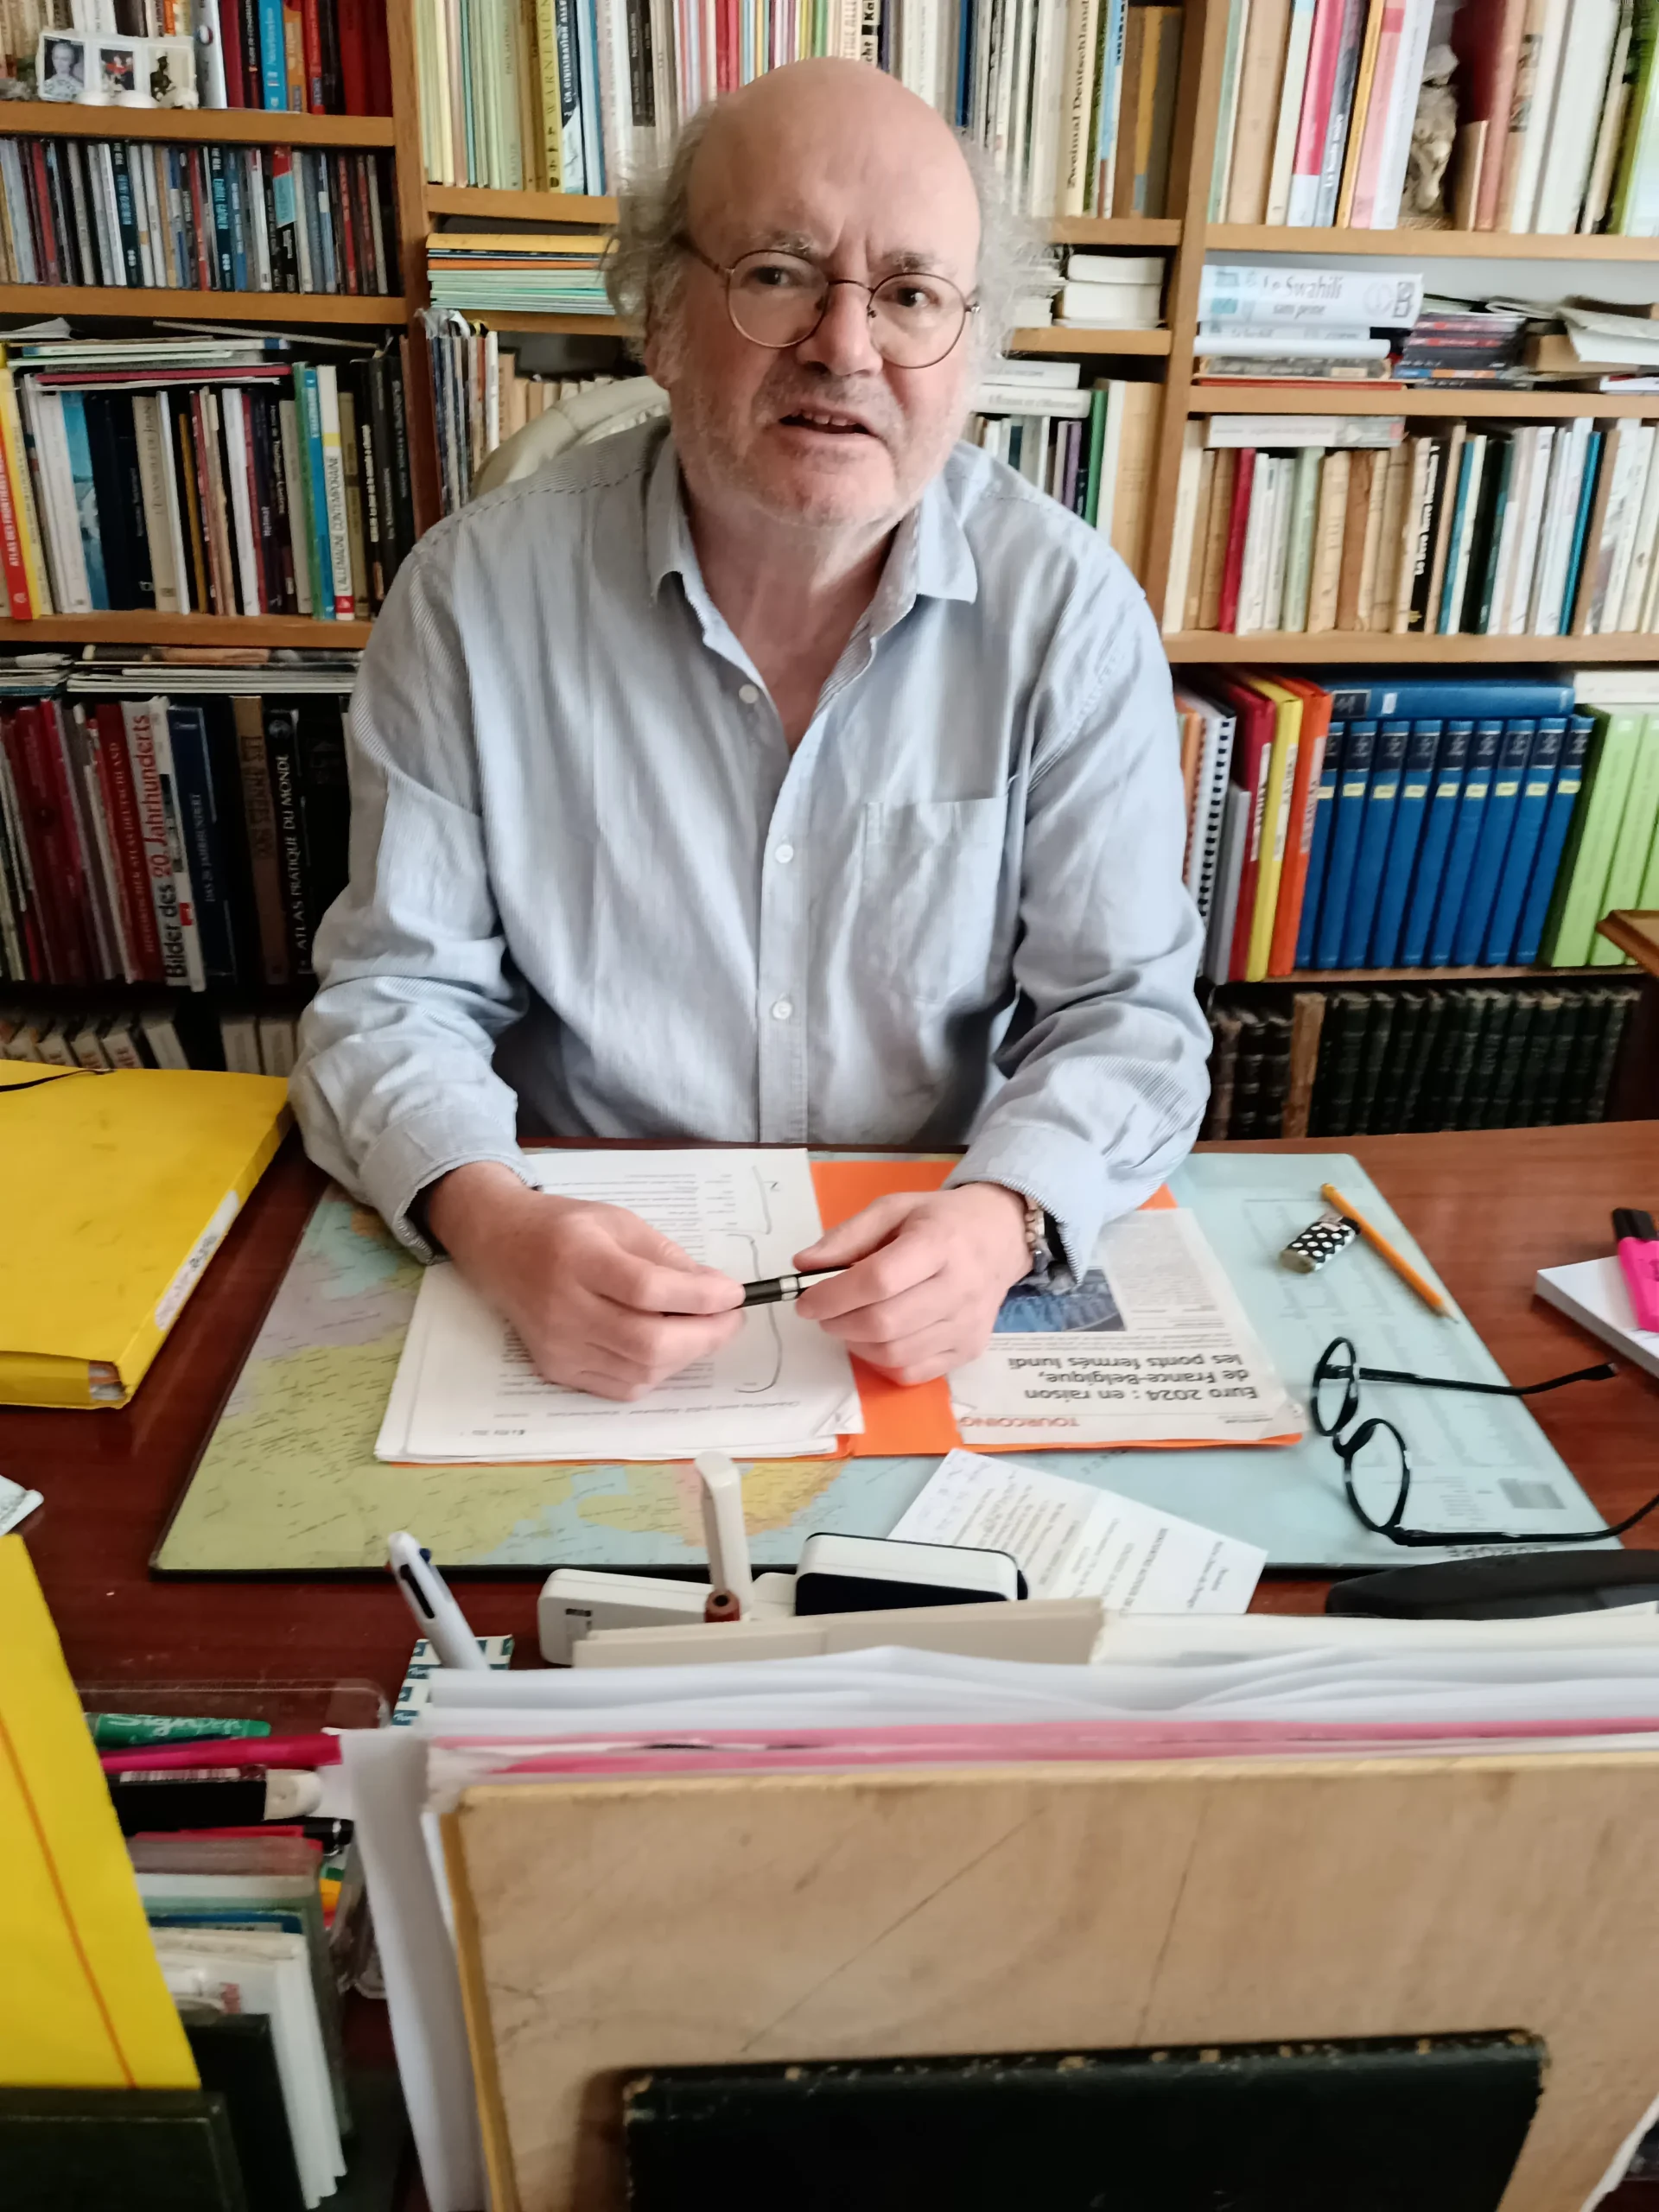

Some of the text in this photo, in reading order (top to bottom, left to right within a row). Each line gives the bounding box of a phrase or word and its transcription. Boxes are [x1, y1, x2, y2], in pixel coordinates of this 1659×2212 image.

[1066, 0, 1090, 189] Zweimal Deutschland
[1286, 275, 1344, 299] Swahili
[328, 456, 345, 532] CONTEMPORAINE
[275, 753, 294, 807] MONDE
[283, 811, 296, 830] DU
[132, 715, 187, 977] Bilder des 20. Jahrhunderts
[283, 836, 303, 896] PRATIQUE
[1007, 1353, 1243, 1371] les ponts fermés lundi
[1038, 1369, 1249, 1386] de France-Belgique,
[1024, 1389, 1090, 1404] raison
[1097, 1389, 1124, 1401] en
[1146, 1388, 1204, 1402] 2024
[1209, 1386, 1258, 1402] Euro
[959, 1414, 1080, 1428] TOURCOING
